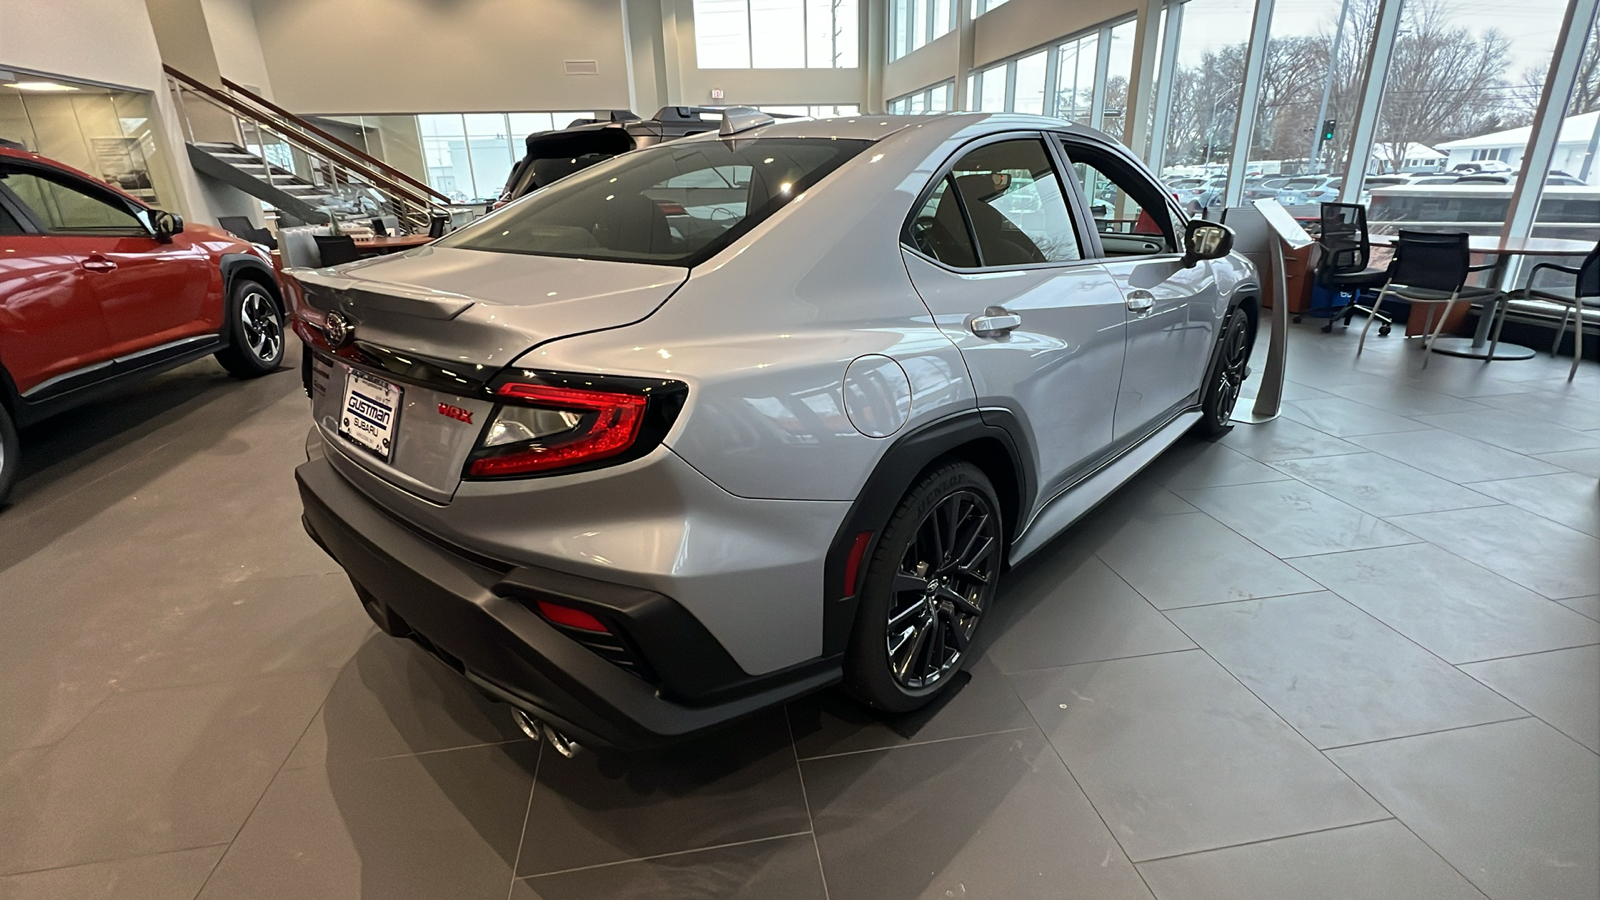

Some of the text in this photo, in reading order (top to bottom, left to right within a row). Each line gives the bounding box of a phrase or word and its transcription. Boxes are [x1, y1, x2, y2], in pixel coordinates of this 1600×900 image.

[438, 402, 473, 424] WRX
[353, 417, 379, 437] SUBARU
[916, 473, 965, 519] DUNLOP
